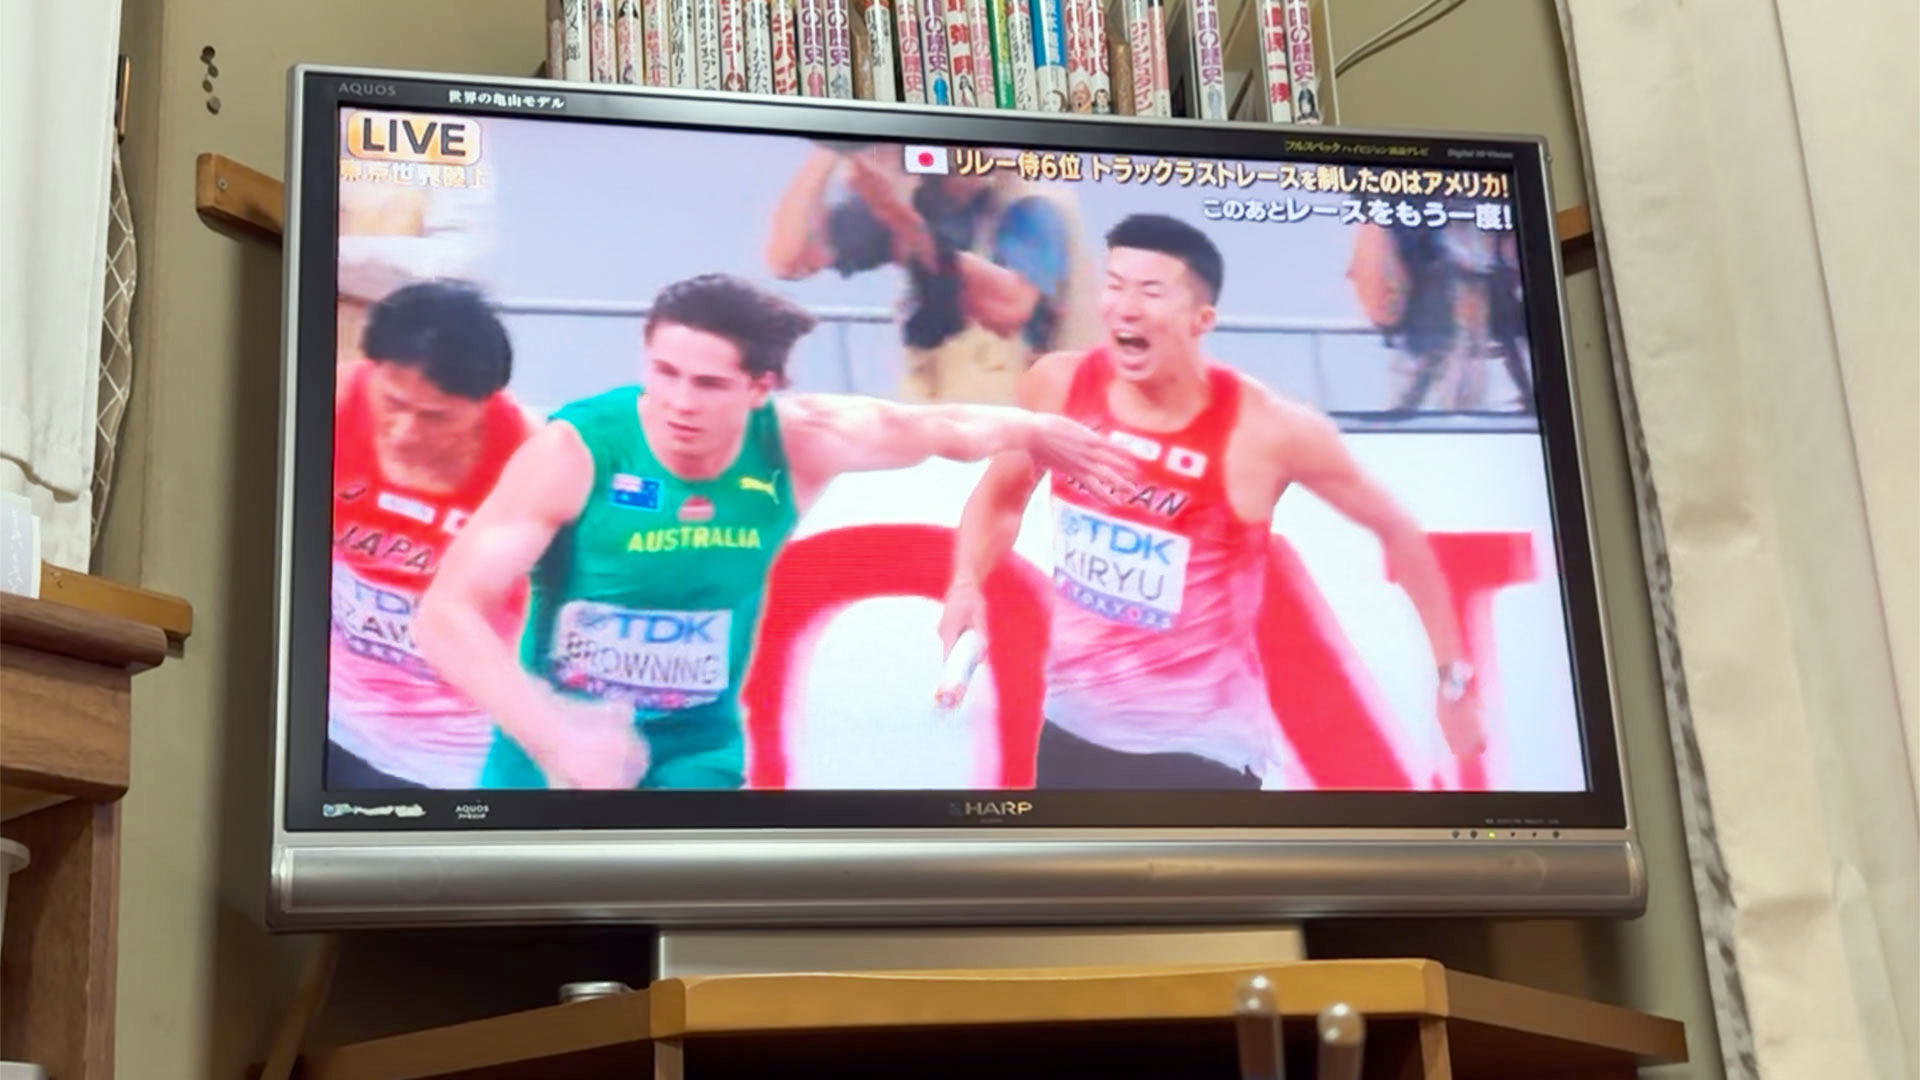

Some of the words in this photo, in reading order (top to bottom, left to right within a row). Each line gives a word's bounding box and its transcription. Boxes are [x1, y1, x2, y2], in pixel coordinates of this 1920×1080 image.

[1287, 0, 1314, 82] 国の歴史
[338, 82, 396, 96] AQUOS
[448, 89, 565, 108] 世界の亀山モデル
[362, 117, 467, 156] LIVE
[956, 148, 1082, 180] リレー侍6位
[334, 525, 432, 571] JAPA
[626, 526, 761, 552] AUSTRALIA
[1080, 512, 1175, 566] TDK
[1064, 547, 1164, 601] KIRYU
[354, 578, 411, 615] TD
[612, 610, 717, 644] TDK
[566, 632, 722, 684] BROWNING
[456, 805, 489, 813] AQUOS
